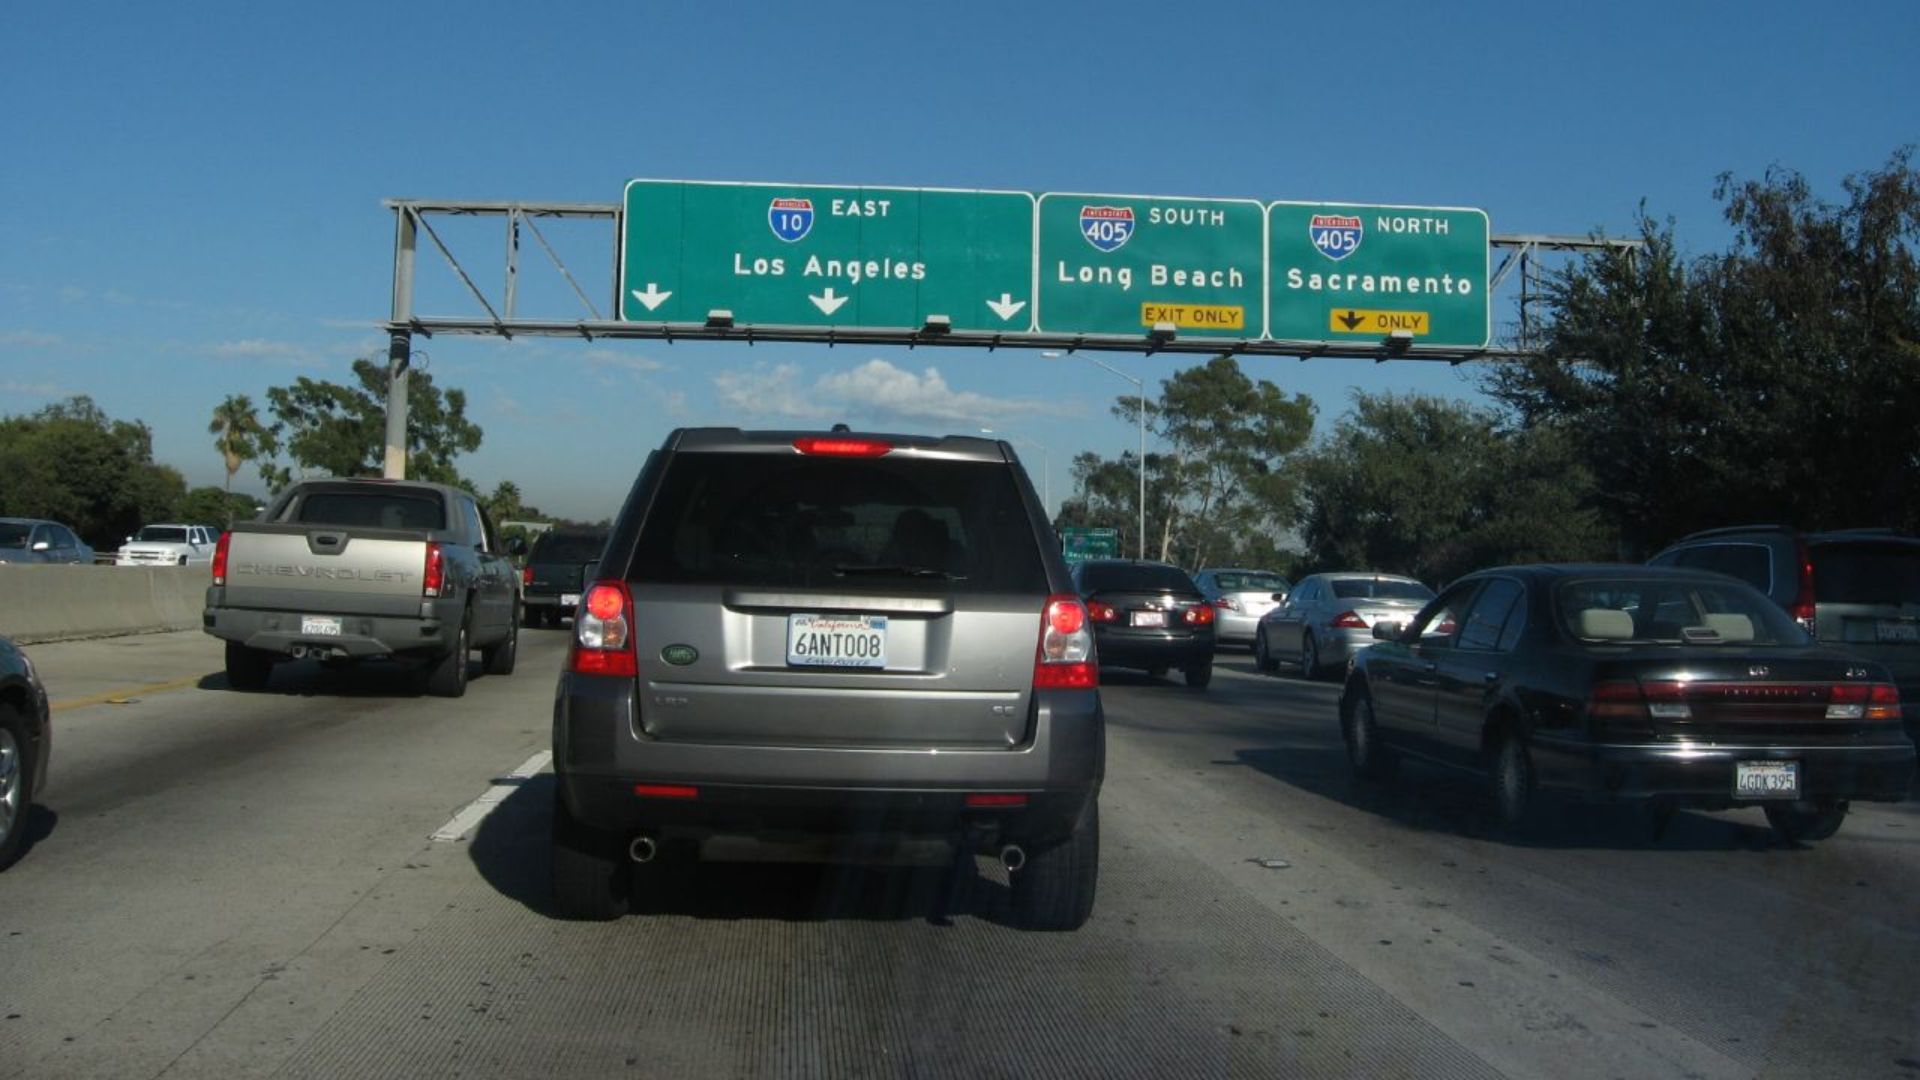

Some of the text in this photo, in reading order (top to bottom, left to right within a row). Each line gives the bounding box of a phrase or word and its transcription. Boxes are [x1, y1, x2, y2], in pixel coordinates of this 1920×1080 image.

[831, 198, 891, 217] EAST
[1149, 206, 1226, 227] SOUTH
[781, 213, 803, 232] 10
[1086, 220, 1129, 243] 405
[1377, 215, 1449, 235] NORTH
[1316, 229, 1356, 251] 405
[734, 252, 927, 285] Los Angeles
[1058, 260, 1243, 291] Long Beach
[1287, 267, 1473, 295] Sacramento
[1144, 306, 1240, 325] EXIT ONLY
[1377, 314, 1423, 329] ONLY
[236, 560, 415, 583] CHEVROLET
[795, 632, 881, 658] 6ANT008
[1739, 773, 1795, 791] 4GDK395
